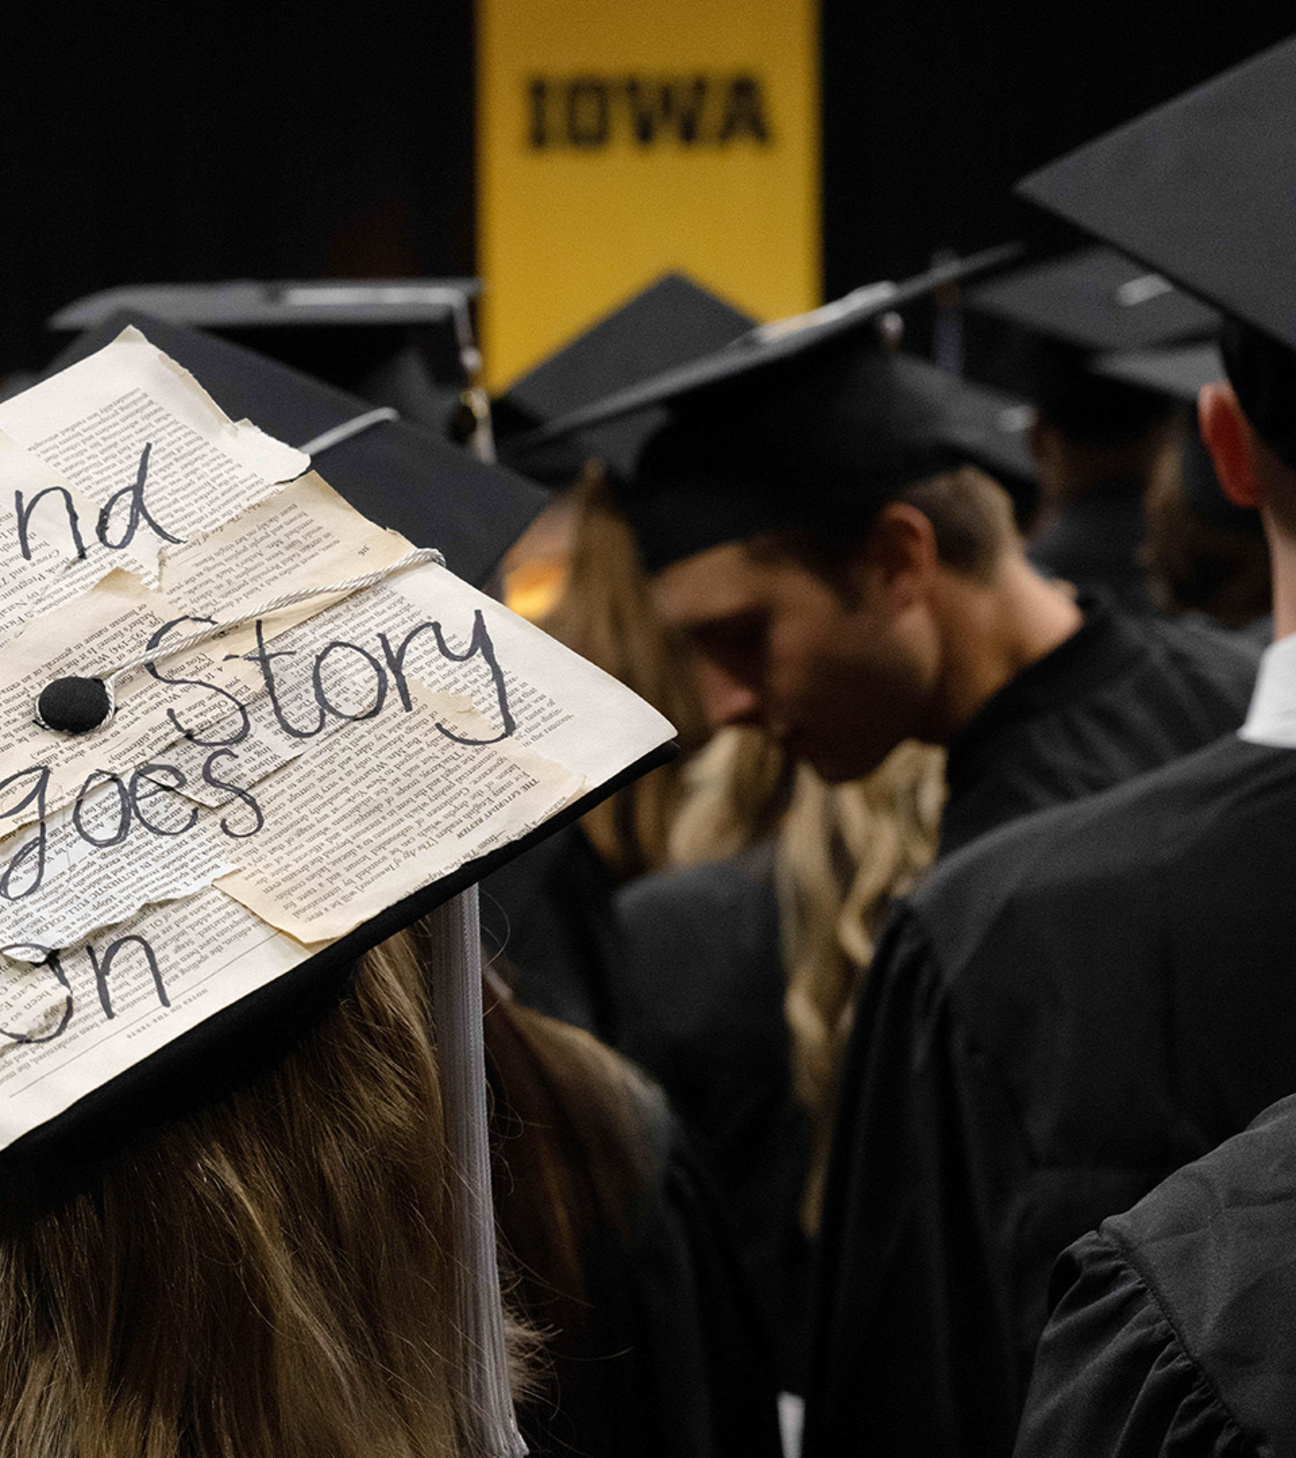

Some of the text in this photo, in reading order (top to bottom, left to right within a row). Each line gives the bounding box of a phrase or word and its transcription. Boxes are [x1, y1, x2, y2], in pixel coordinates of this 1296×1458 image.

[527, 73, 773, 150] IOWA
[28, 548, 61, 568] Crown
[8, 565, 28, 579] and
[136, 603, 147, 611] or
[108, 609, 139, 629] human
[82, 626, 110, 645] nature
[95, 630, 125, 650] future?
[73, 642, 84, 651] in
[85, 646, 97, 655] Is
[40, 647, 75, 670] general,
[64, 658, 80, 669] the
[78, 652, 89, 660] it
[78, 652, 110, 673] Whose
[20, 674, 32, 683] an
[32, 668, 42, 676] or
[45, 666, 66, 681] fault
[144, 609, 516, 746] Story
[35, 678, 47, 687] of
[1, 686, 30, 704] person
[2, 698, 32, 716] dismal
[15, 735, 28, 744] be
[27, 729, 40, 738] to
[513, 770, 530, 782] For
[489, 779, 513, 797] many
[460, 795, 494, 820] English
[434, 817, 464, 839] readers
[291, 763, 520, 918] lation of the depths which can be sounded by international
[329, 899, 343, 909] be
[339, 890, 358, 903] will
[163, 925, 253, 986] edition, the spelling and
[10, 982, 38, 1002] Lara
[22, 990, 53, 1011] been
[78, 1021, 100, 1036] been
[15, 1062, 32, 1073] the
